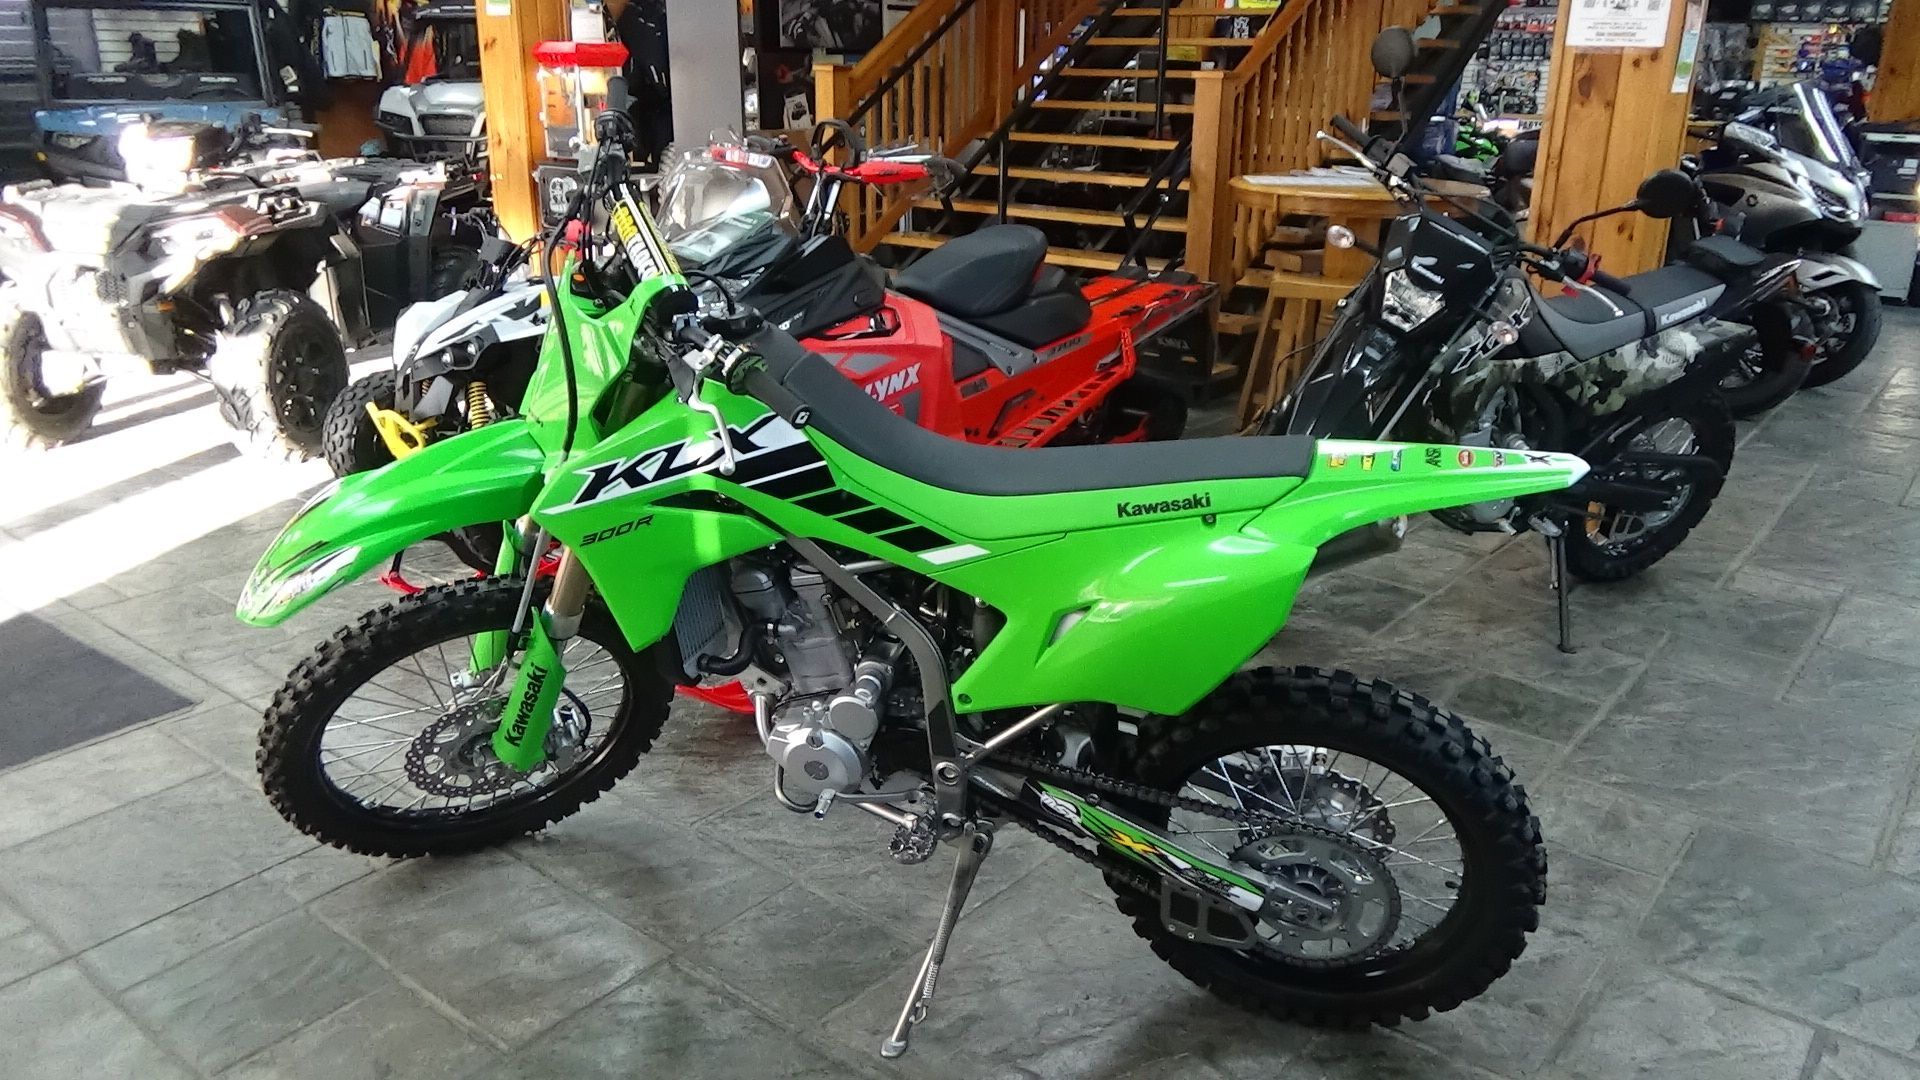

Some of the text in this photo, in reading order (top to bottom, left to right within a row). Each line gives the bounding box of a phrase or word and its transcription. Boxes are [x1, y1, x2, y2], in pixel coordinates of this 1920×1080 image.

[1661, 297, 1707, 326] Kawasaki
[573, 412, 778, 505] KLX
[1117, 492, 1211, 518] Kawasaki
[580, 515, 654, 547] 300R
[504, 661, 548, 748] Kawasaki
